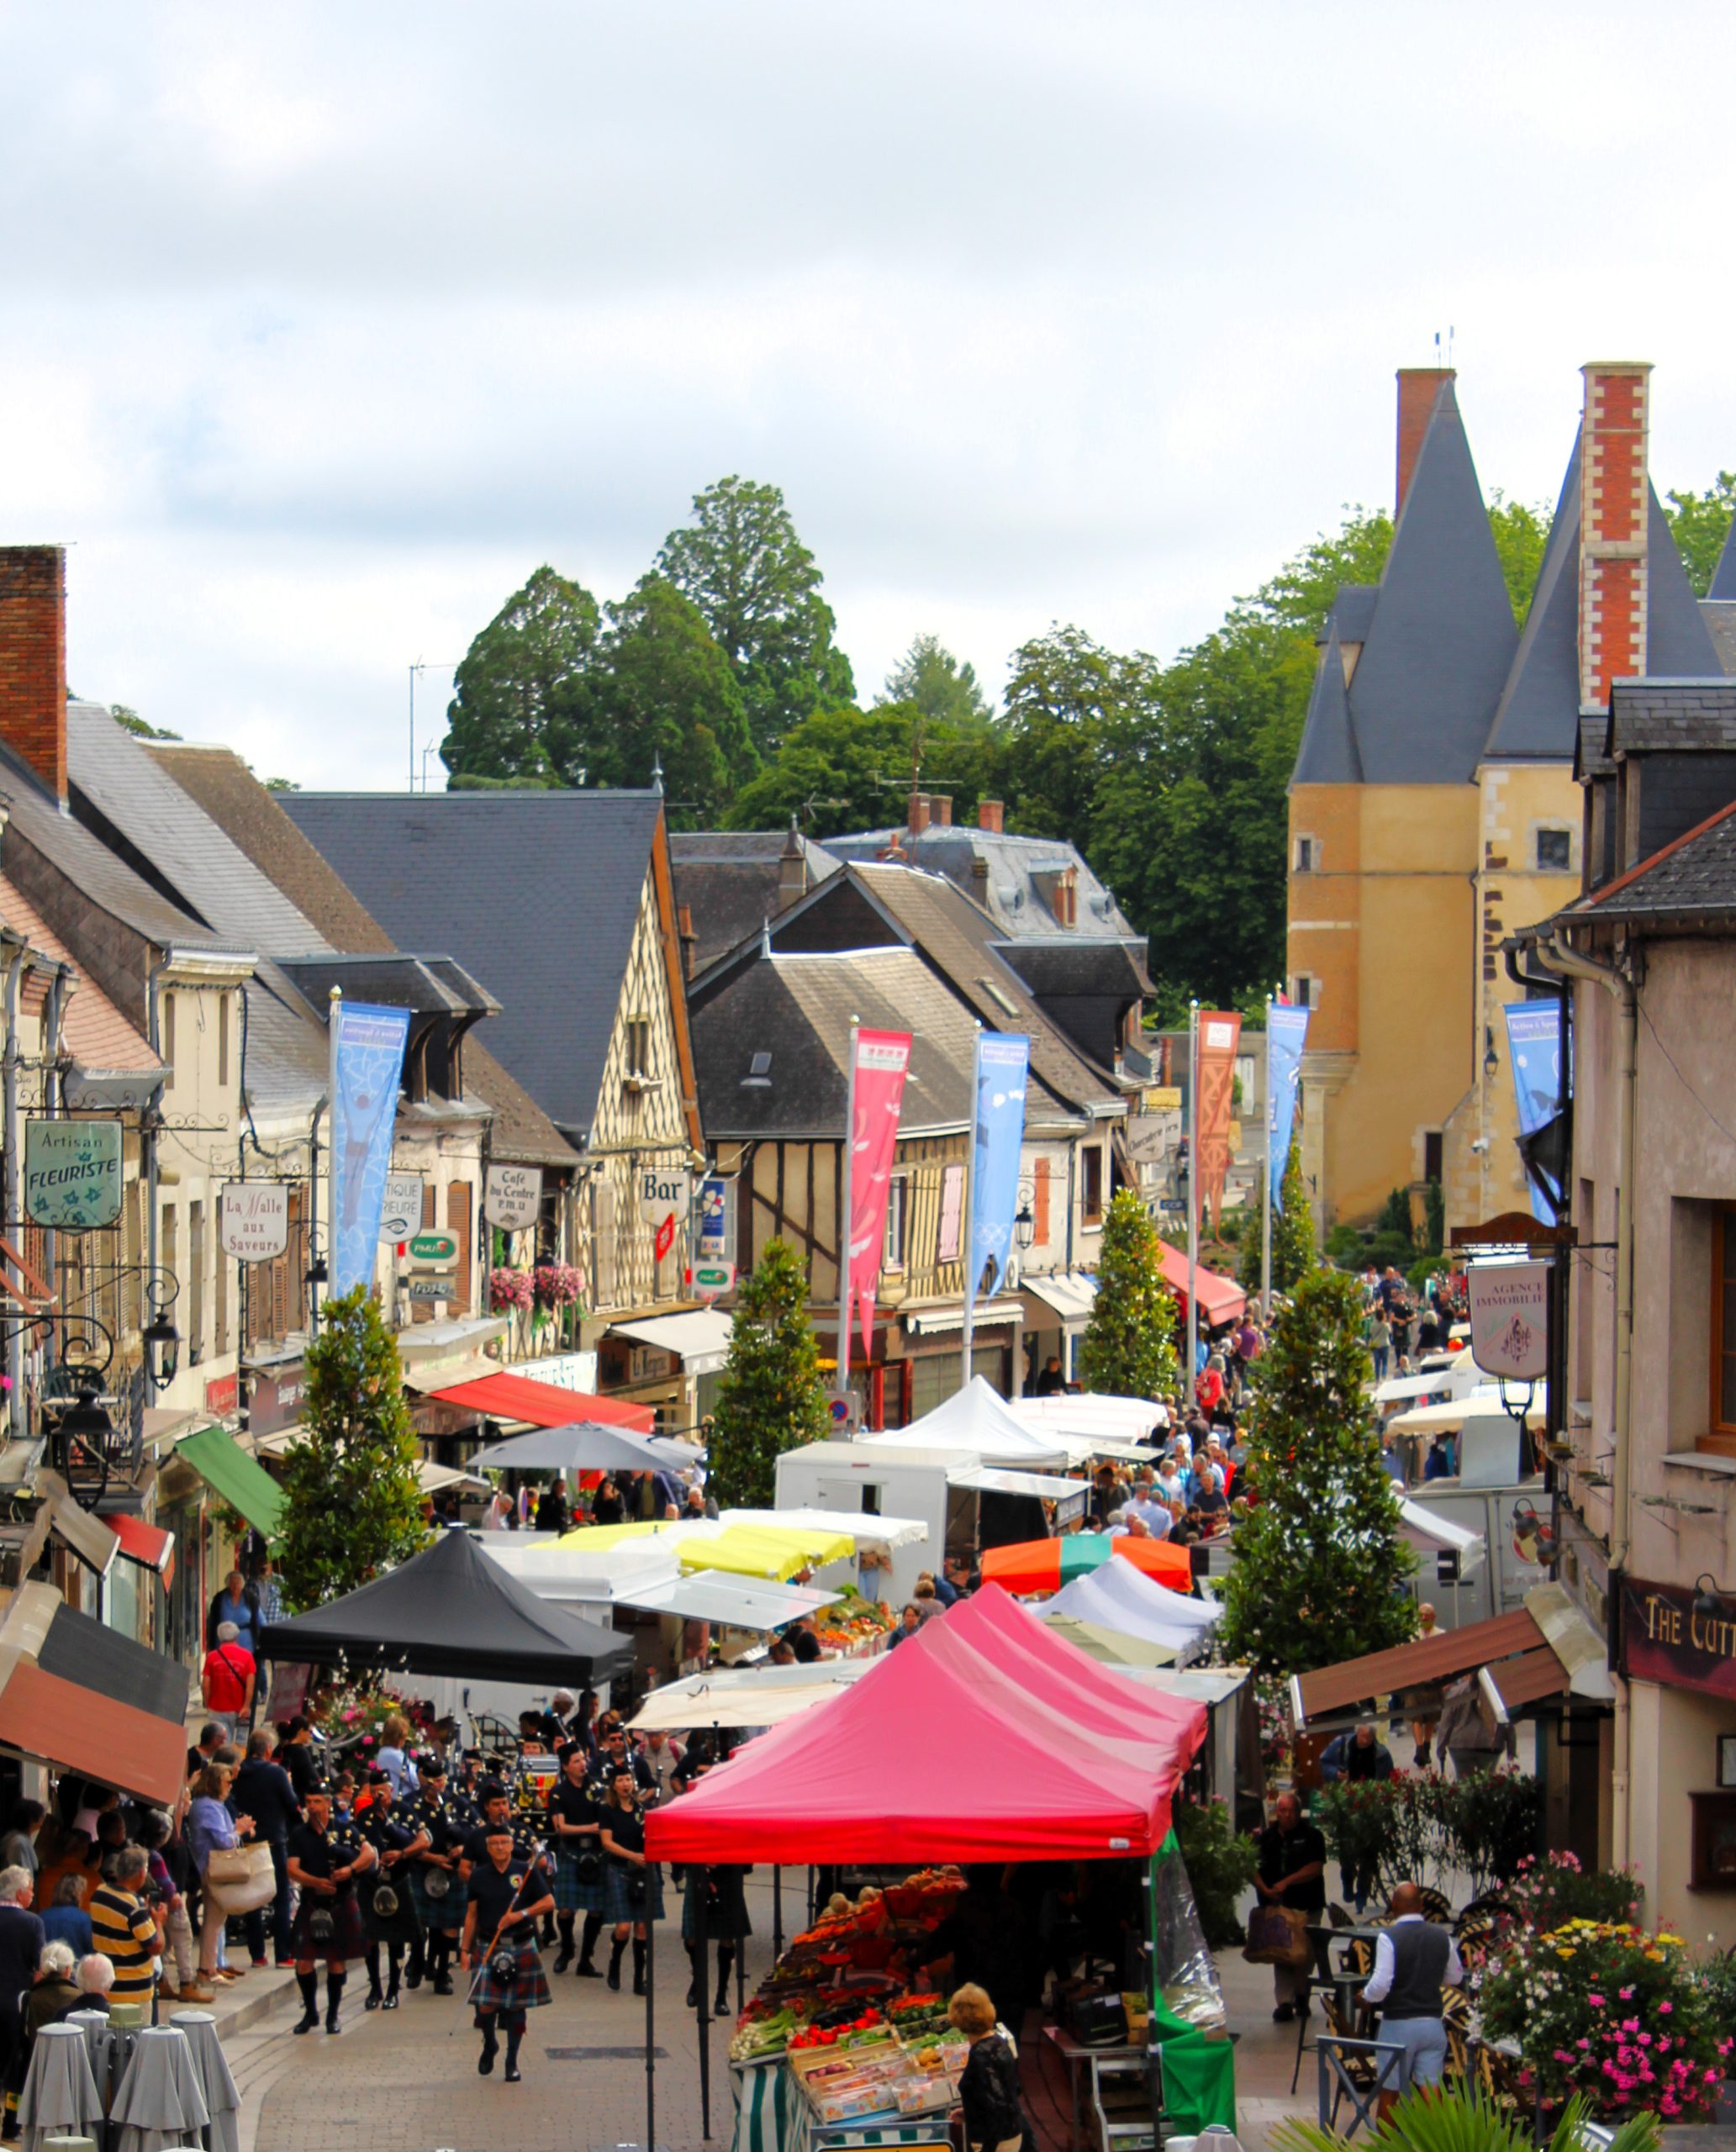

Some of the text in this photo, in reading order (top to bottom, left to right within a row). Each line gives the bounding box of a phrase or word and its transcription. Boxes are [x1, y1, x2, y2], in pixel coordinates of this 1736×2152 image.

[41, 1131, 103, 1148] Artisan
[29, 1158, 118, 1191] FLEURISTE
[643, 1174, 683, 1201] Bar
[226, 1196, 243, 1216] La
[243, 1223, 265, 1233] aux
[230, 1235, 279, 1252] Saveurs
[414, 1244, 436, 1253] PMU
[1644, 1596, 1681, 1645] THE
